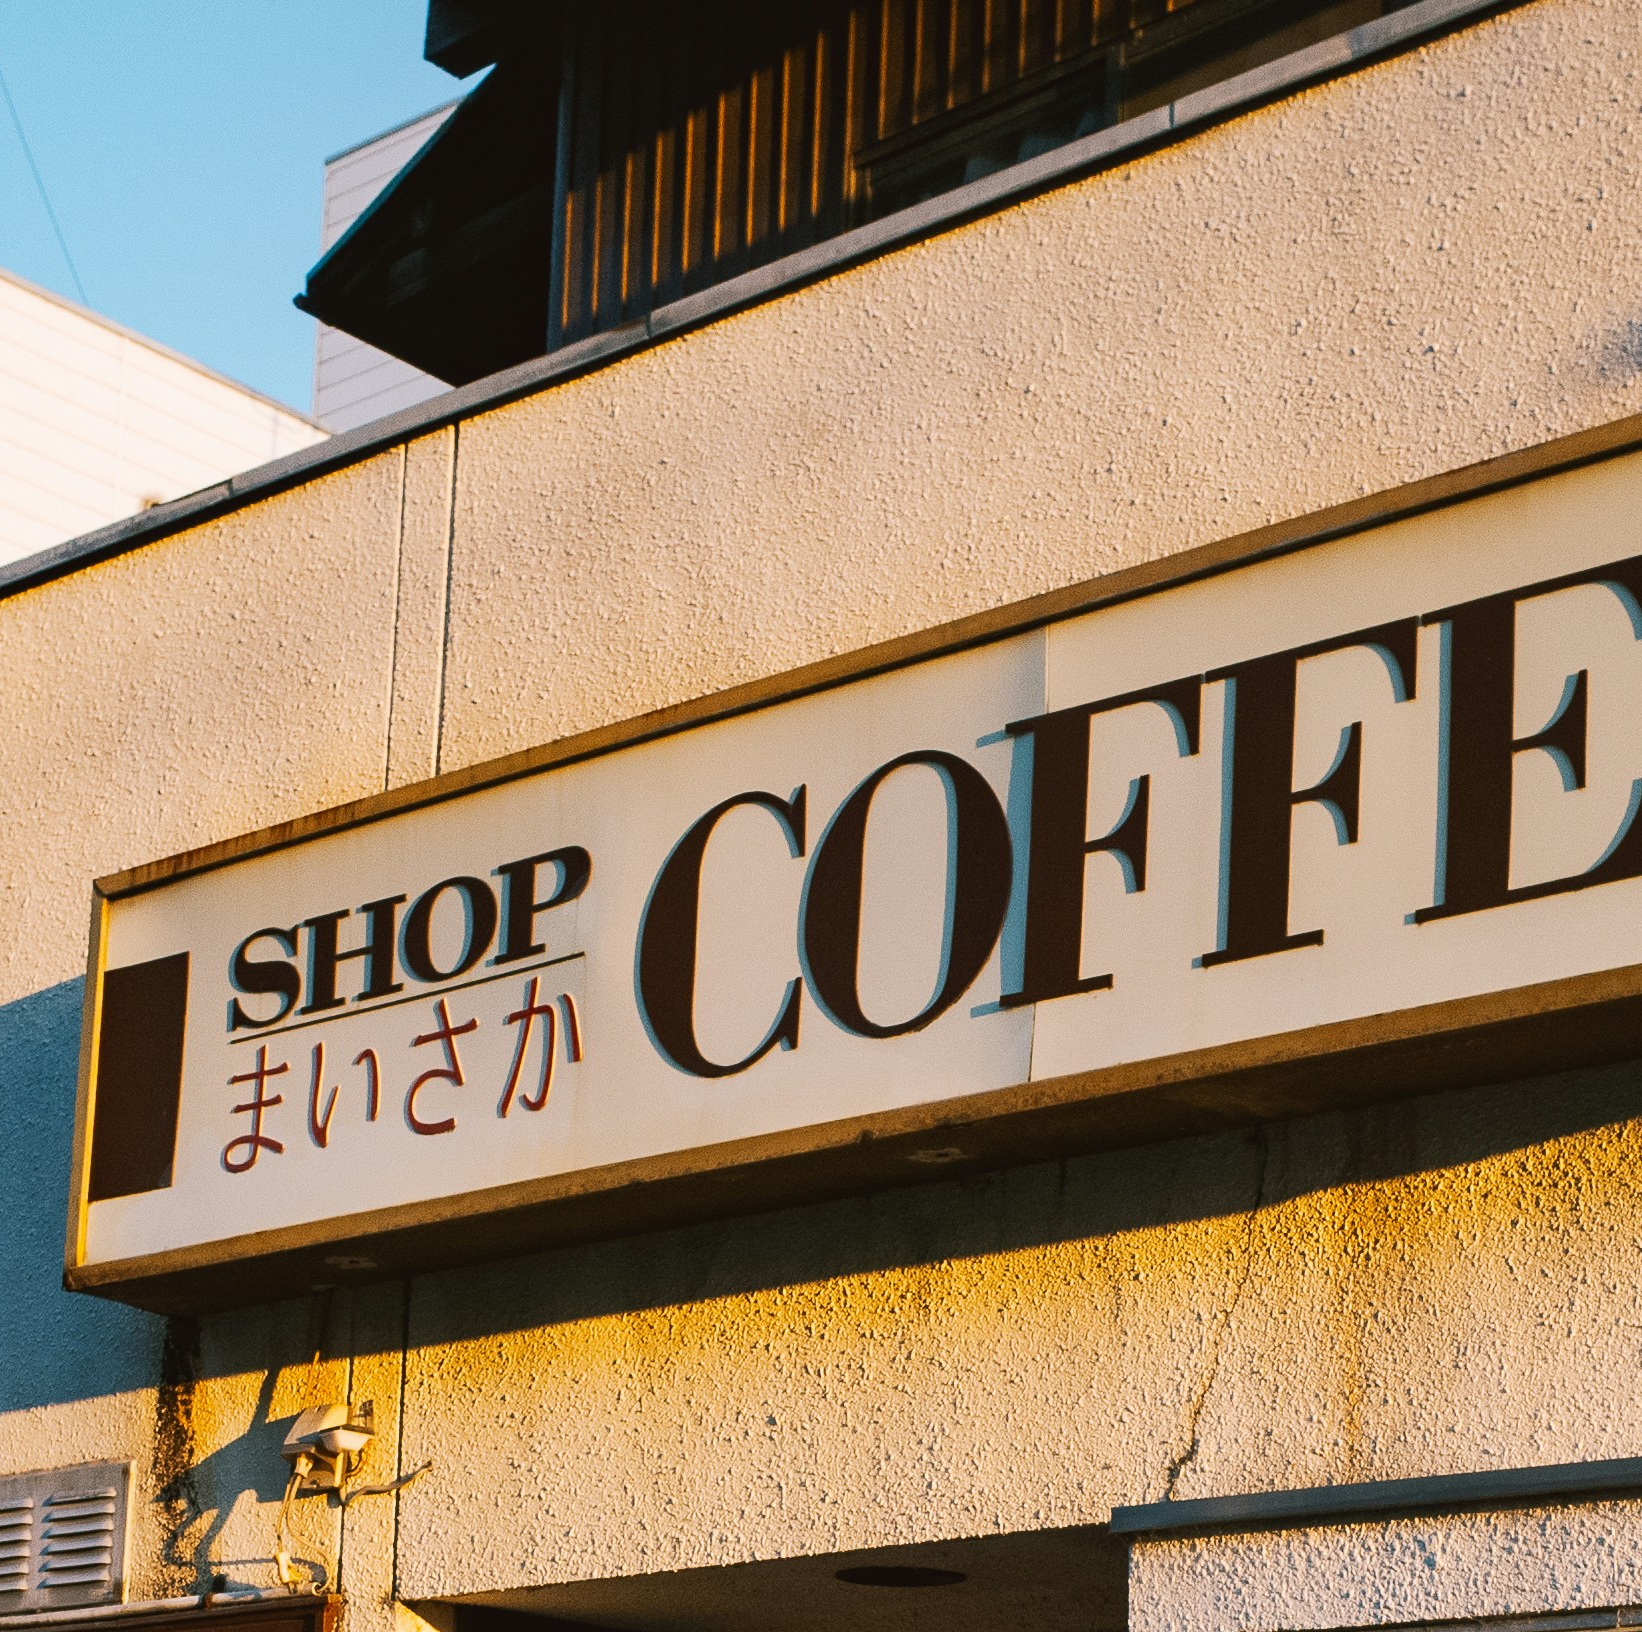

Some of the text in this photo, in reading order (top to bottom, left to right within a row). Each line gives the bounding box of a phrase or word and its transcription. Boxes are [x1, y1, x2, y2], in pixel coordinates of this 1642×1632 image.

[228, 845, 592, 1032] SHOP
[221, 973, 587, 1176] まいさか
